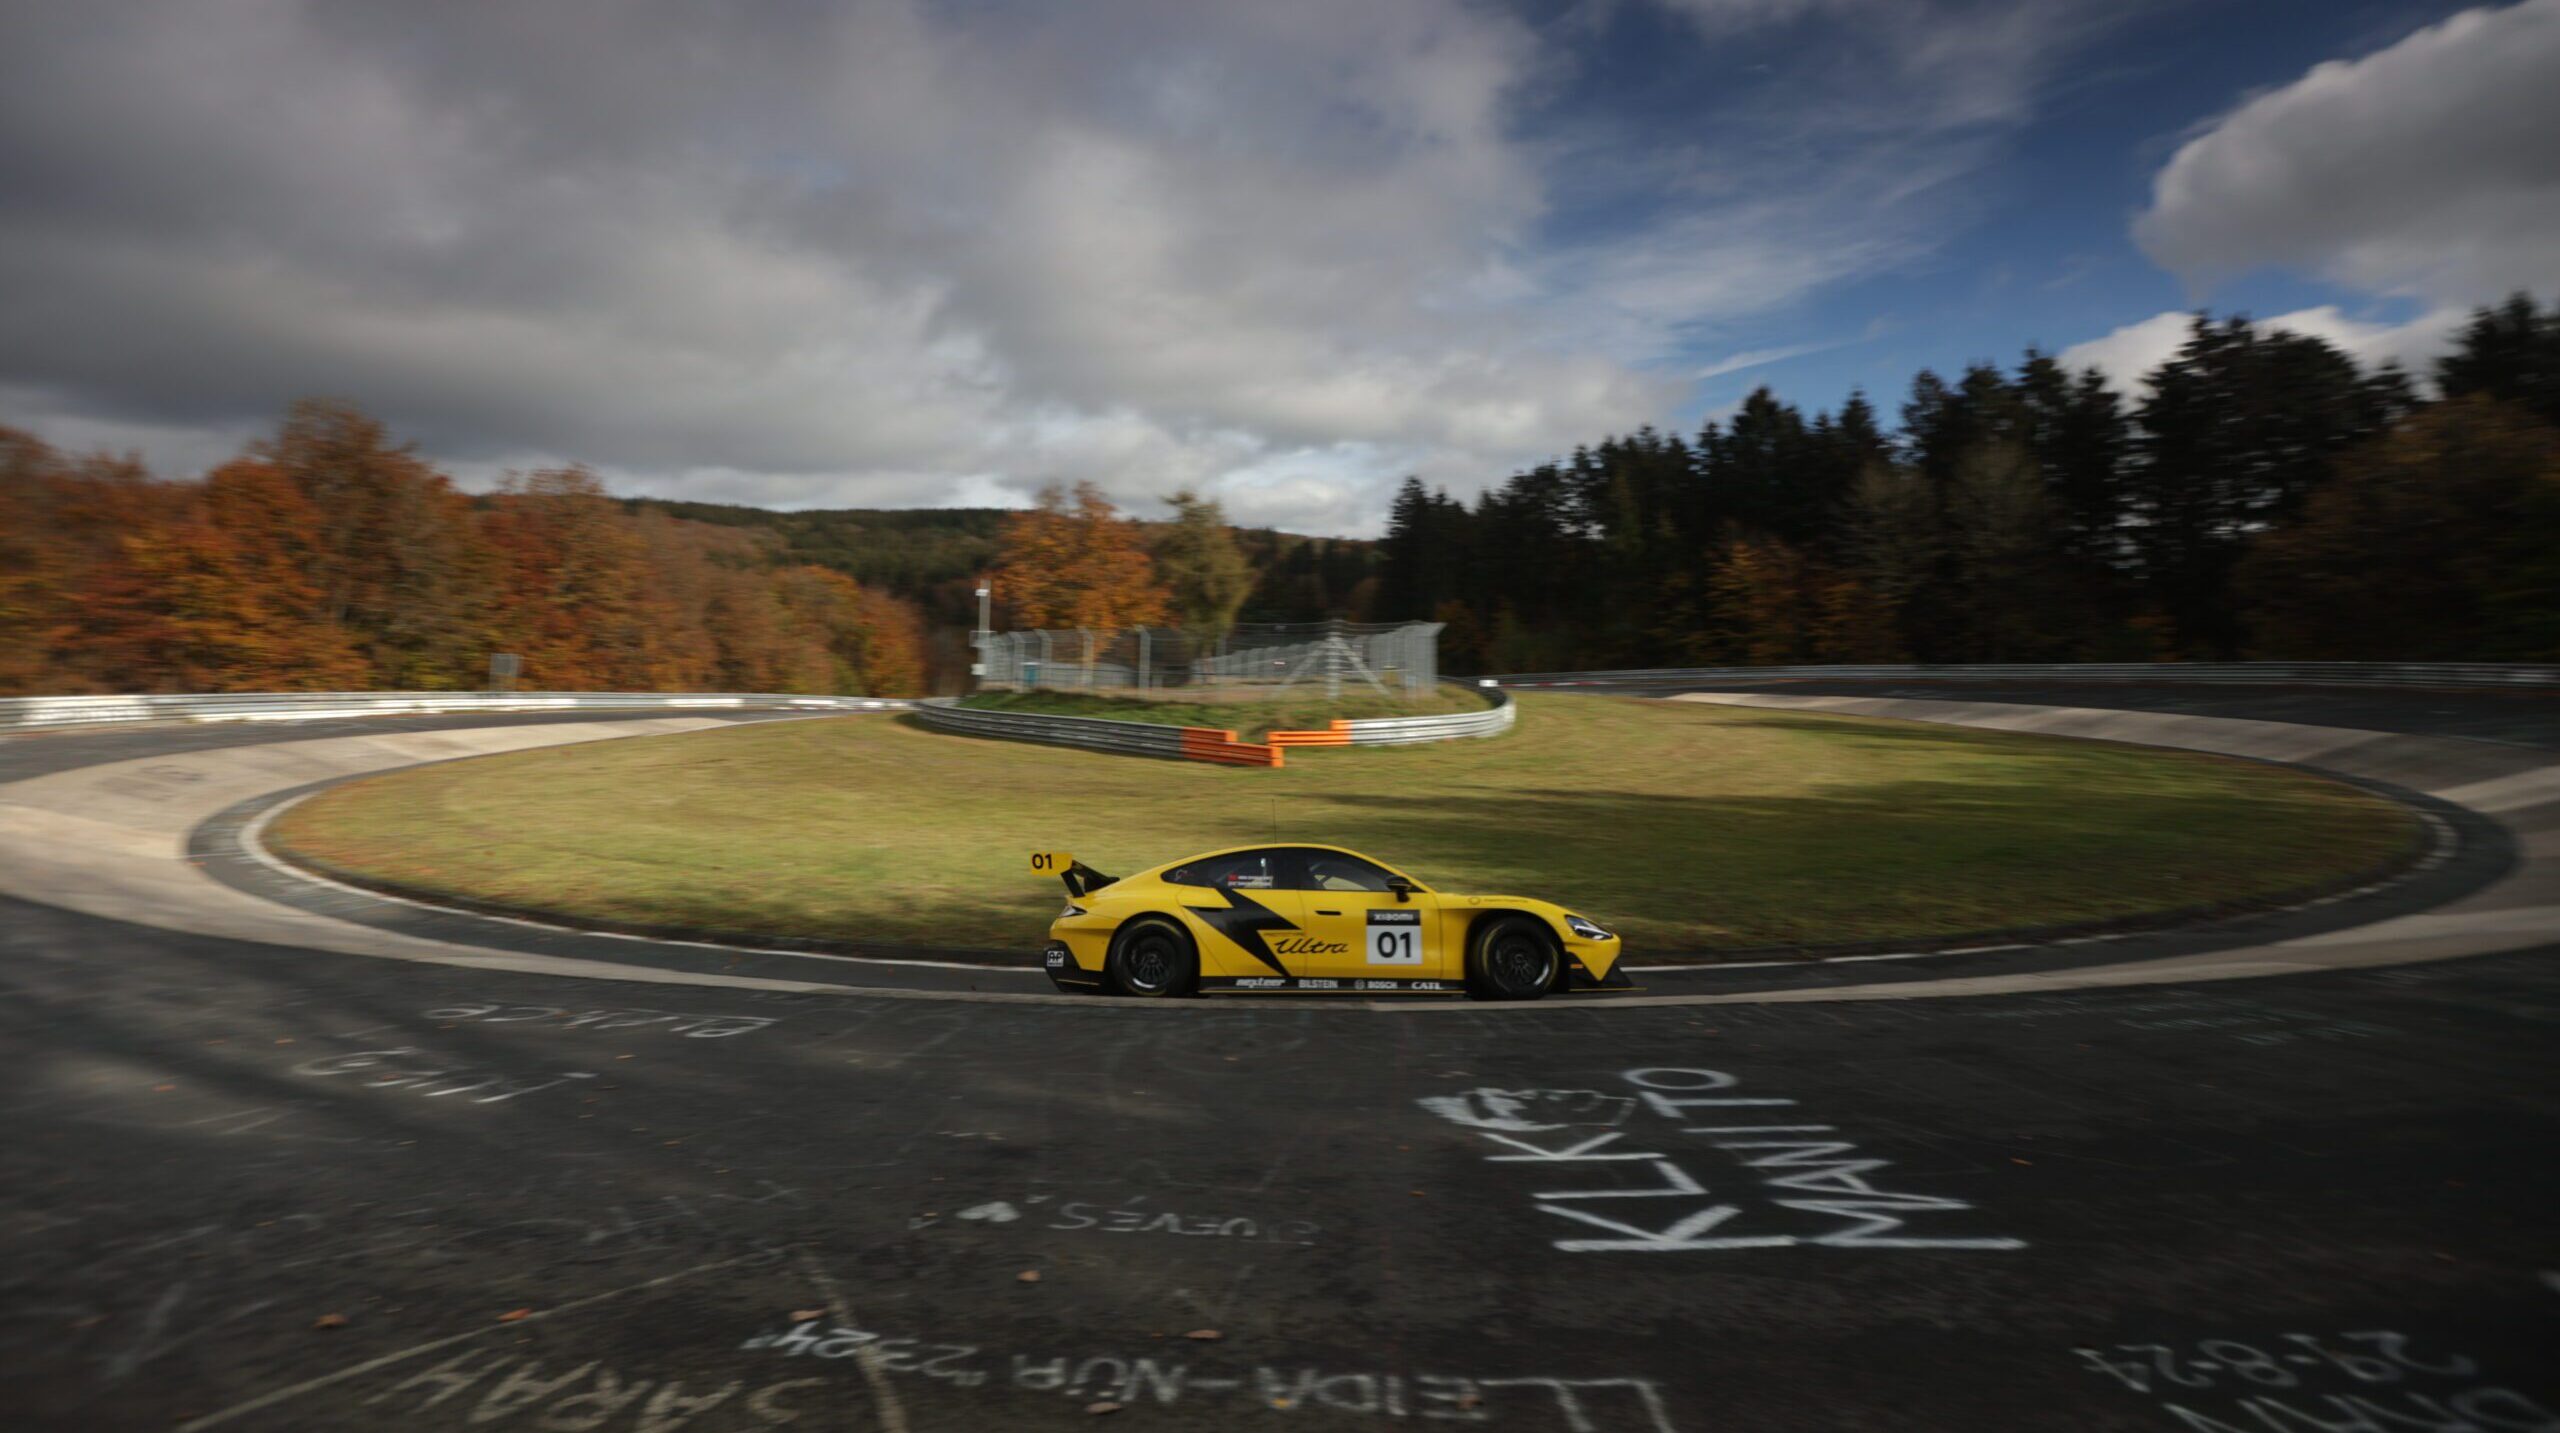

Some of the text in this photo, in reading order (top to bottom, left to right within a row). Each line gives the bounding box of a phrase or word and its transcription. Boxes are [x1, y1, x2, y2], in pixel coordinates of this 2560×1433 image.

[1031, 853, 1053, 869] 01
[1273, 937, 1349, 954] Ultra
[1377, 931, 1411, 958] 01
[1298, 979, 1339, 989] BILSTEIN
[1367, 981, 1399, 990] BOSCH
[1410, 981, 1444, 991] CATL
[1618, 1066, 2030, 1251] MANITO
[2068, 1330, 2479, 1393] 29-8-24
